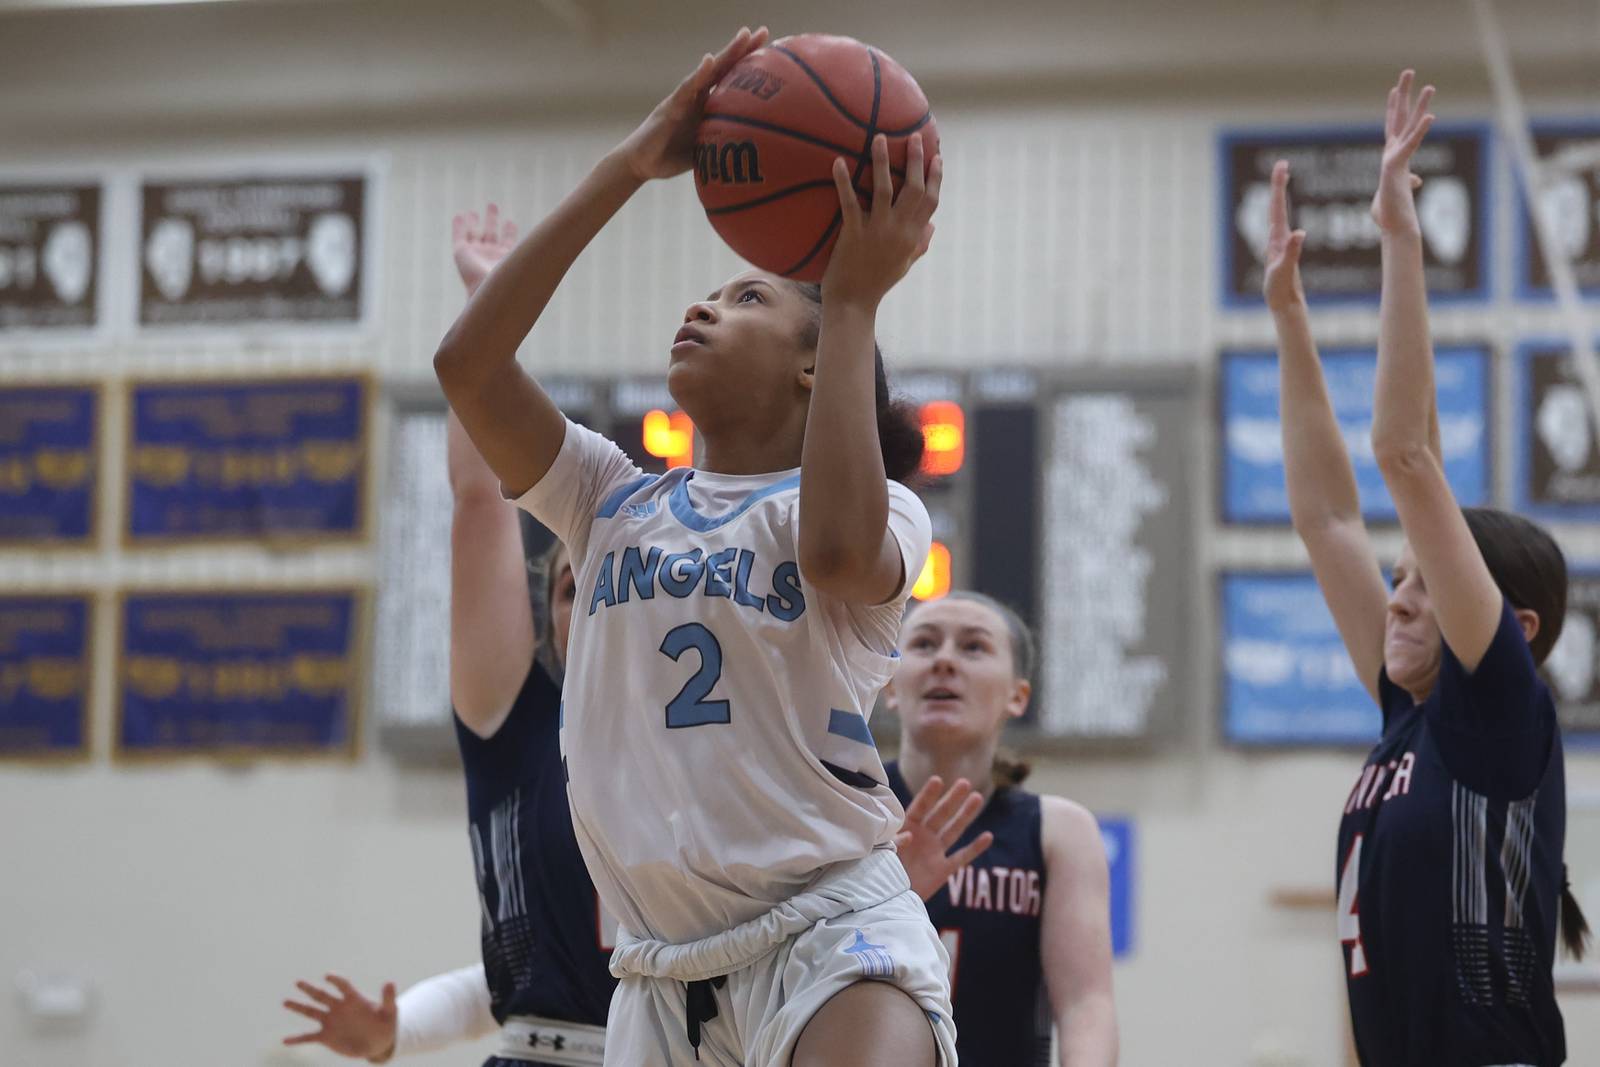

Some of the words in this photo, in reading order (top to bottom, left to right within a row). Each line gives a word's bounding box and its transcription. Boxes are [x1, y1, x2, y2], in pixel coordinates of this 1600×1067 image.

[588, 546, 807, 622] ANGELS
[658, 622, 731, 728] 2
[947, 864, 1041, 917] VIATOR
